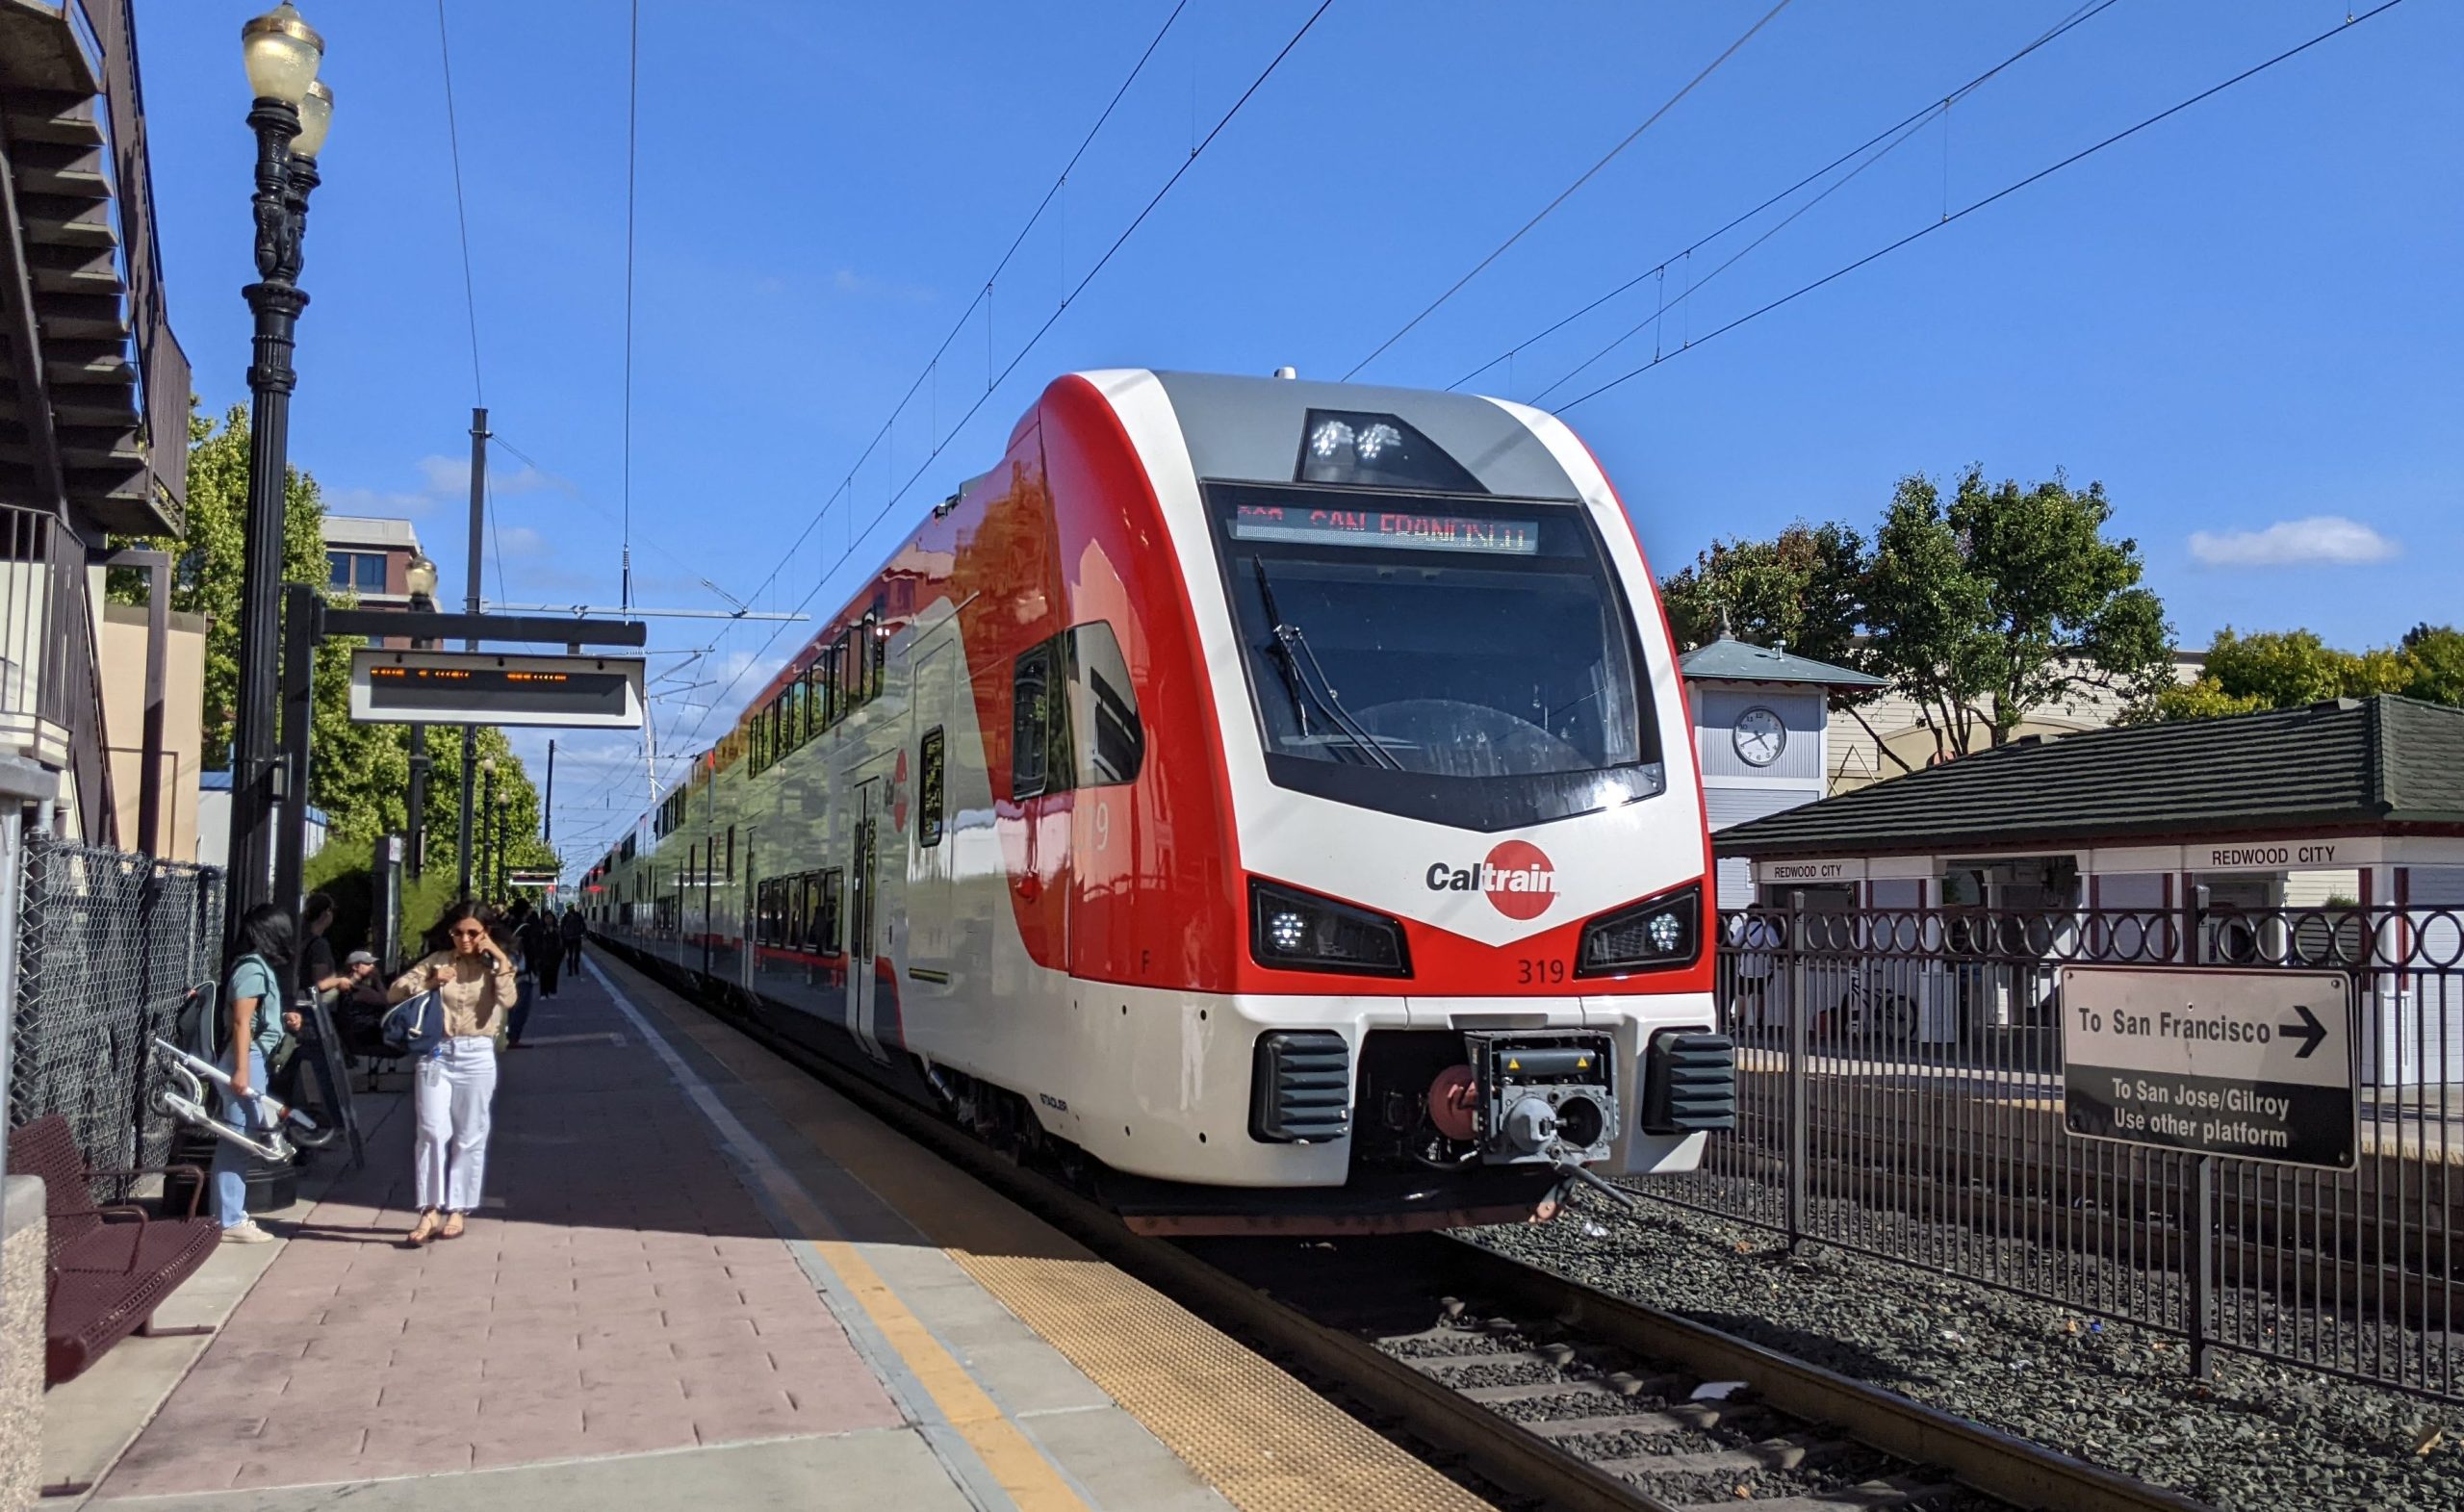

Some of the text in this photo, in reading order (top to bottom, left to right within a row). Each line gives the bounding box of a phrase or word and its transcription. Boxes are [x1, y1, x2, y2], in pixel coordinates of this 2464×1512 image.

[1774, 864, 1842, 878] REDWOOD CITY
[2212, 846, 2336, 865] REDWOOD CITY
[1425, 861, 1557, 893] Caltrain
[1517, 959, 1564, 985] 319
[2078, 1007, 2271, 1044] To San Francisco
[2112, 1077, 2290, 1121] To San Jose/Gilroy
[2114, 1108, 2288, 1148] Use other platform
